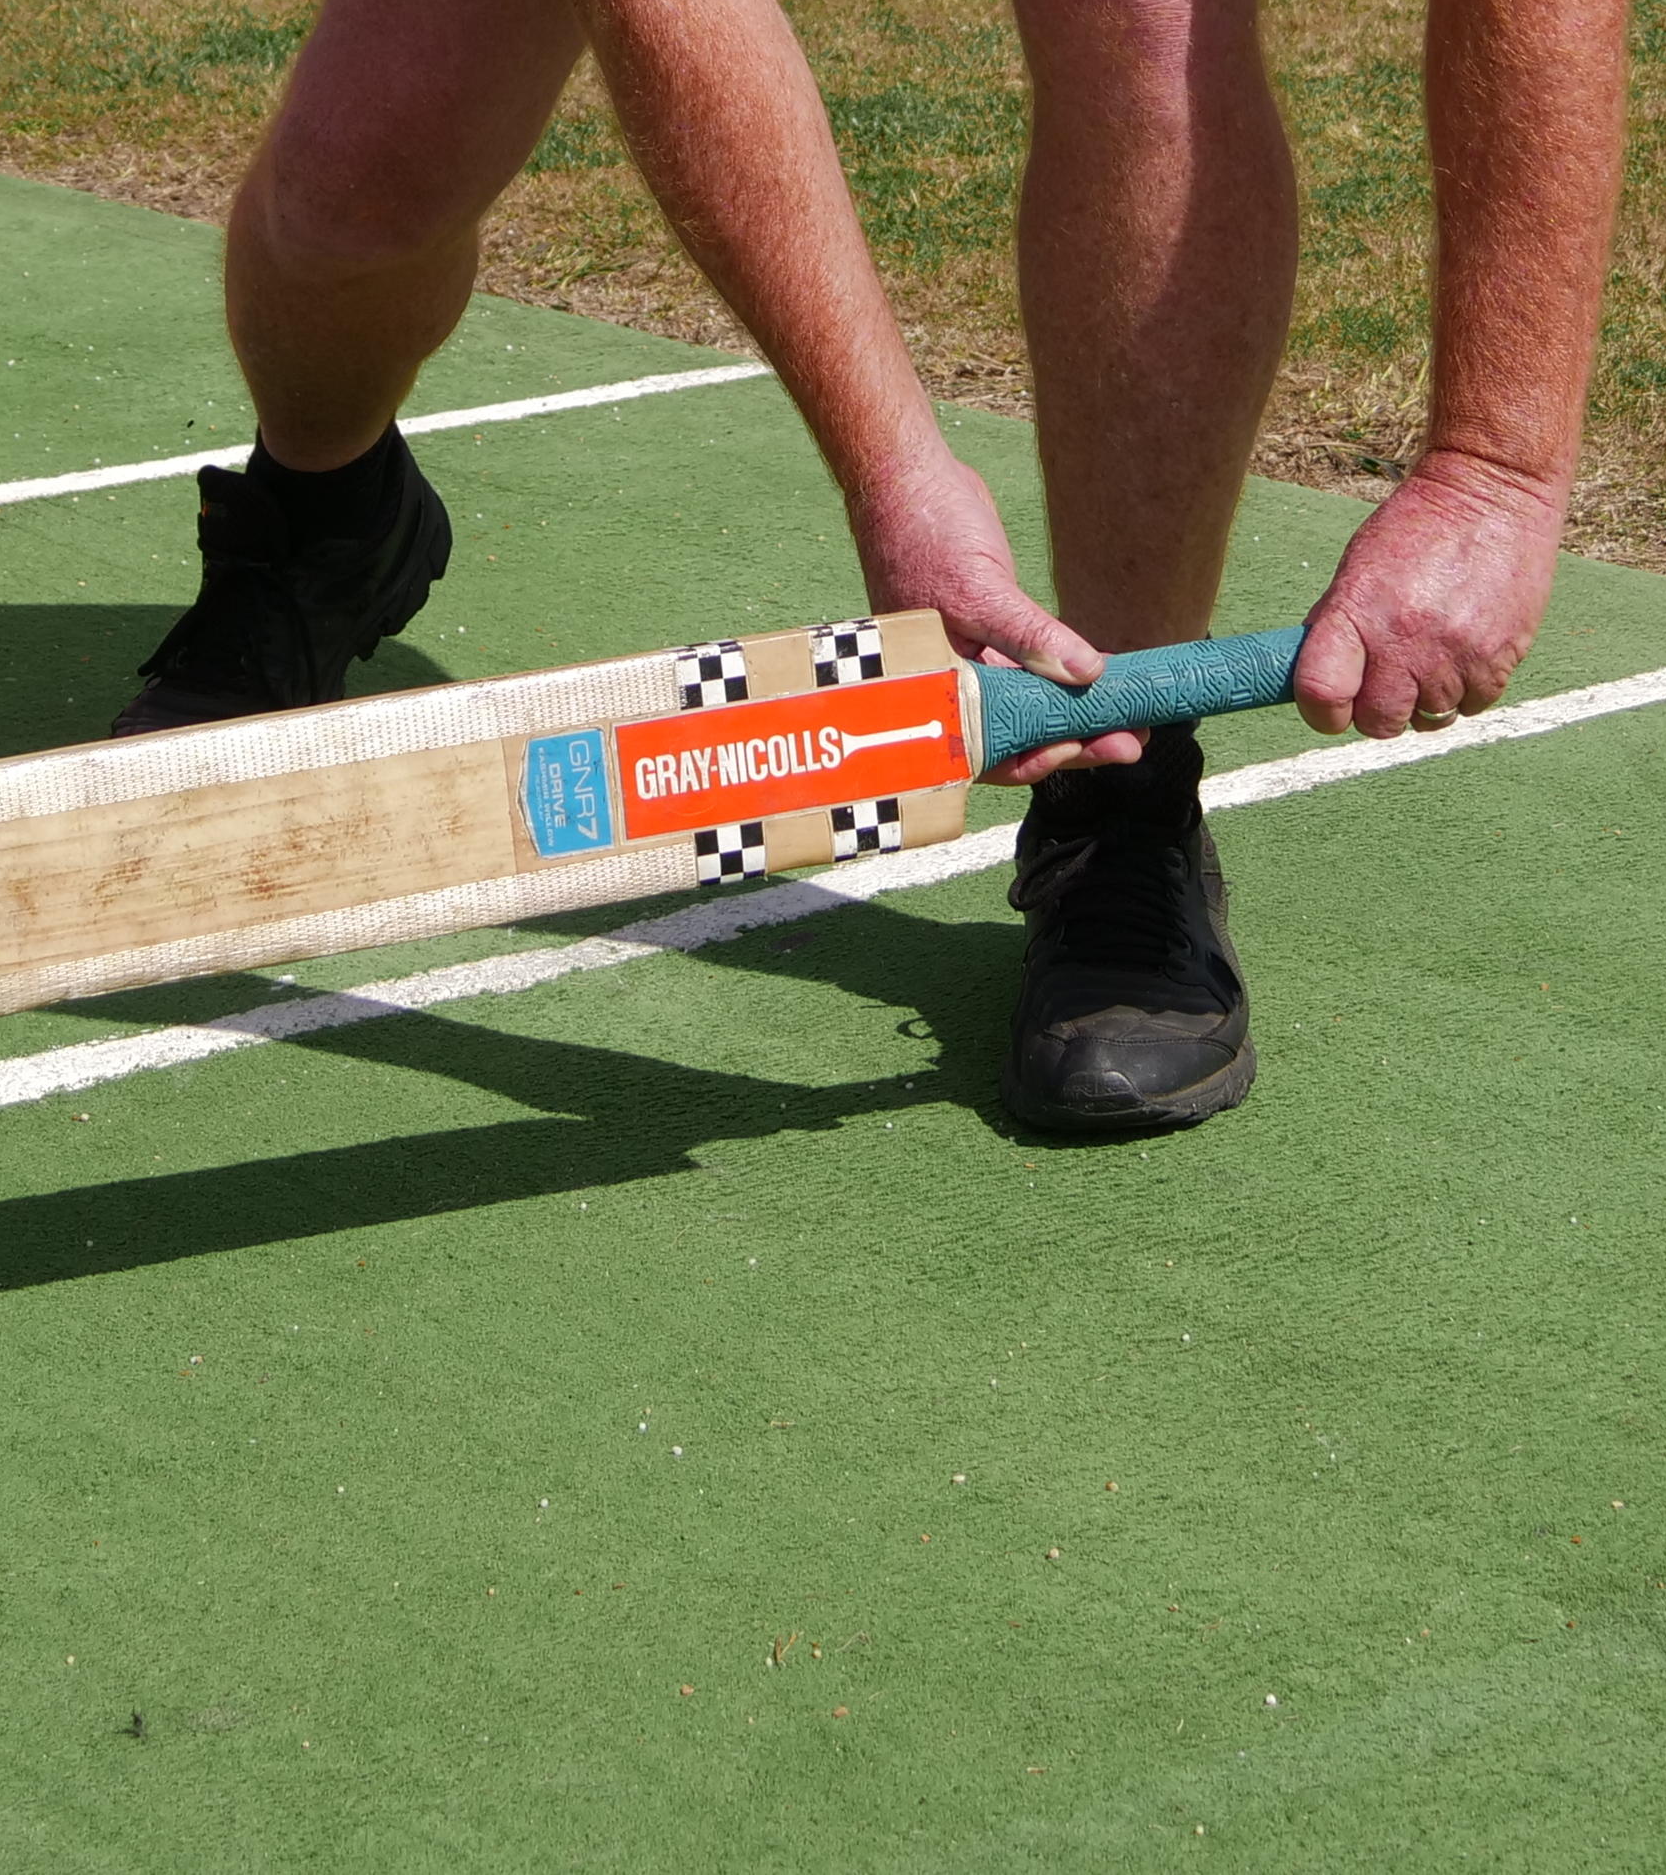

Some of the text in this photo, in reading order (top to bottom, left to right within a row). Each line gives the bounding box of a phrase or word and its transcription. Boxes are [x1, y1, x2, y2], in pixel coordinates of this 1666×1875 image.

[548, 762, 567, 828] DRIVE
[568, 739, 598, 841] GNR7
[634, 725, 844, 801] GRAY-NICOLLS
